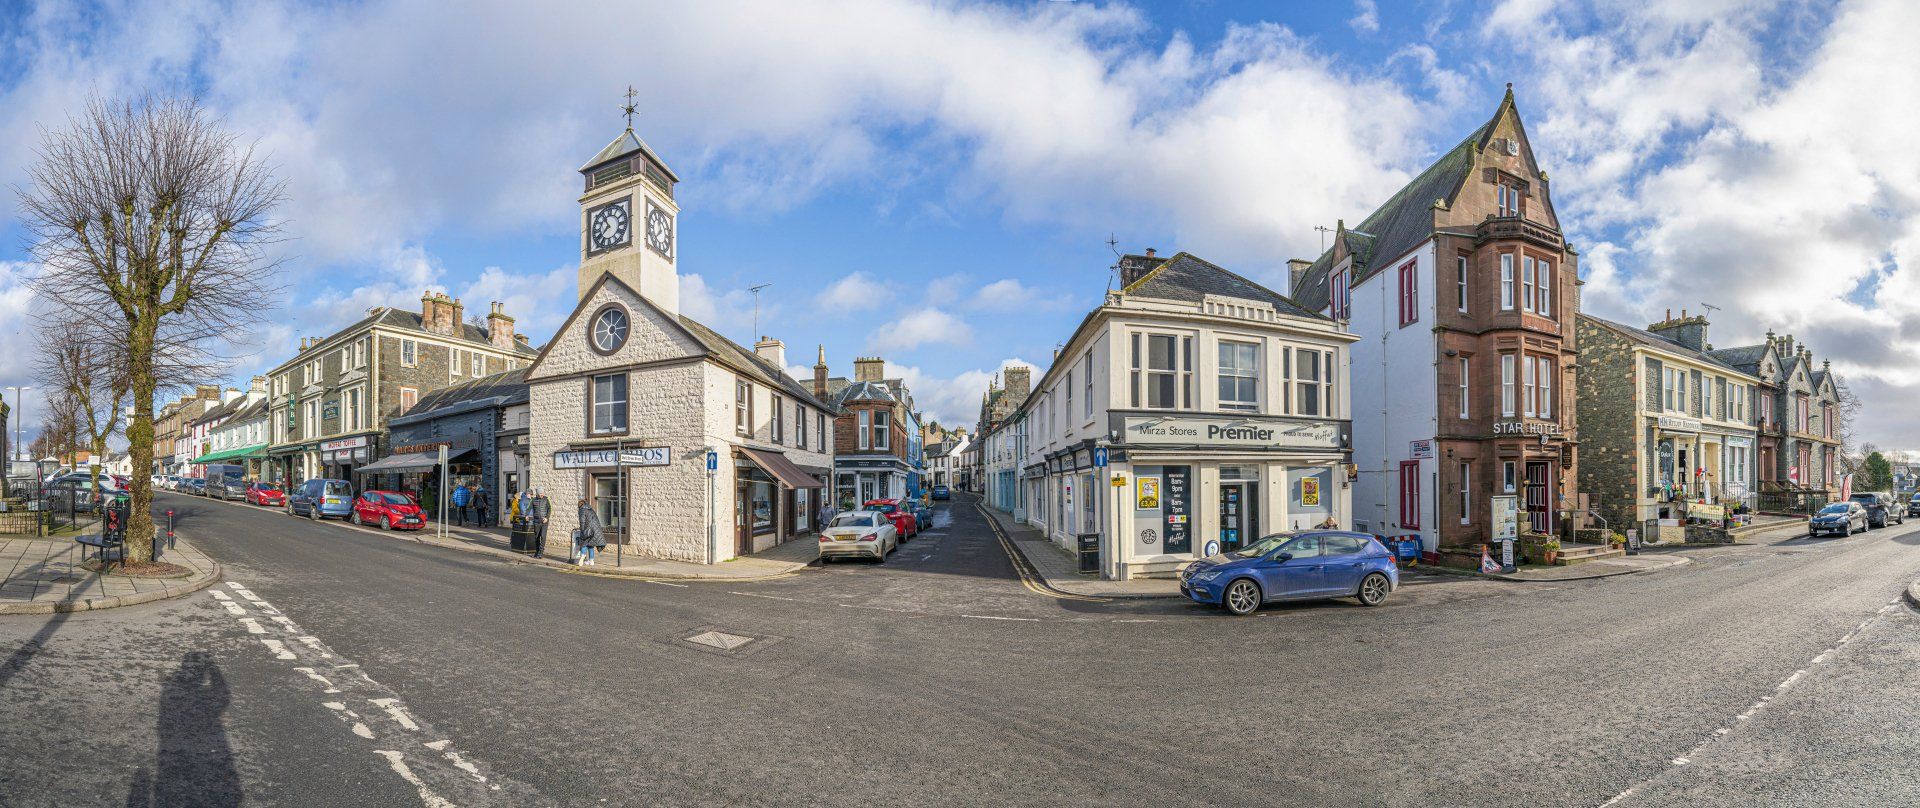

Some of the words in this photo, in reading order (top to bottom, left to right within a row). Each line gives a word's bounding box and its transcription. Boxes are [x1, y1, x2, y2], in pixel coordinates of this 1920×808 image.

[1139, 425, 1166, 435] Mirza
[1169, 425, 1198, 436] Stores
[1207, 424, 1275, 441] Premier
[1493, 422, 1524, 434] STAR
[1530, 423, 1562, 435] HOTEL
